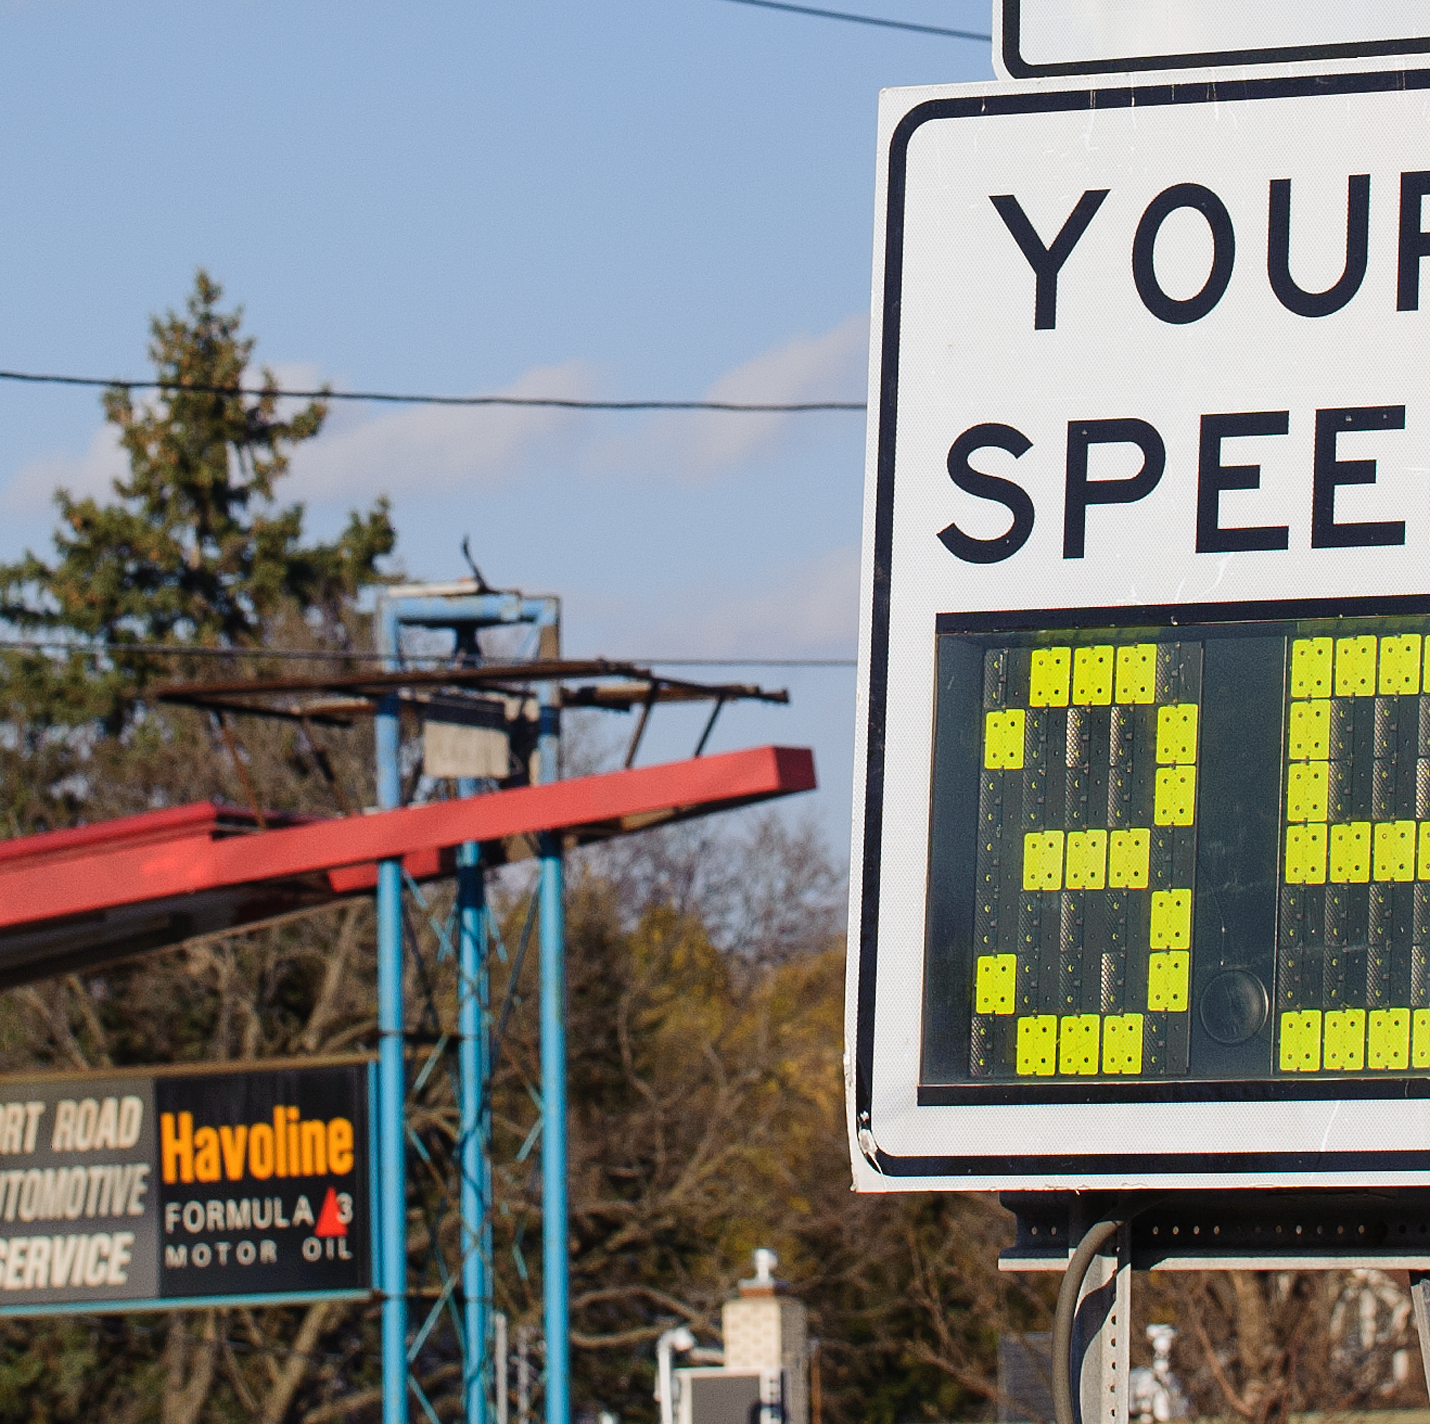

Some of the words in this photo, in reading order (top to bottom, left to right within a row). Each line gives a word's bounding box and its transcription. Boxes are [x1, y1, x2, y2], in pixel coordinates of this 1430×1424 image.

[51, 1095, 144, 1153] ROAD
[159, 1105, 355, 1184] Havoline
[165, 1194, 315, 1233] FORMULA
[165, 1239, 278, 1268] MOTOR
[302, 1236, 353, 1262] OIL
